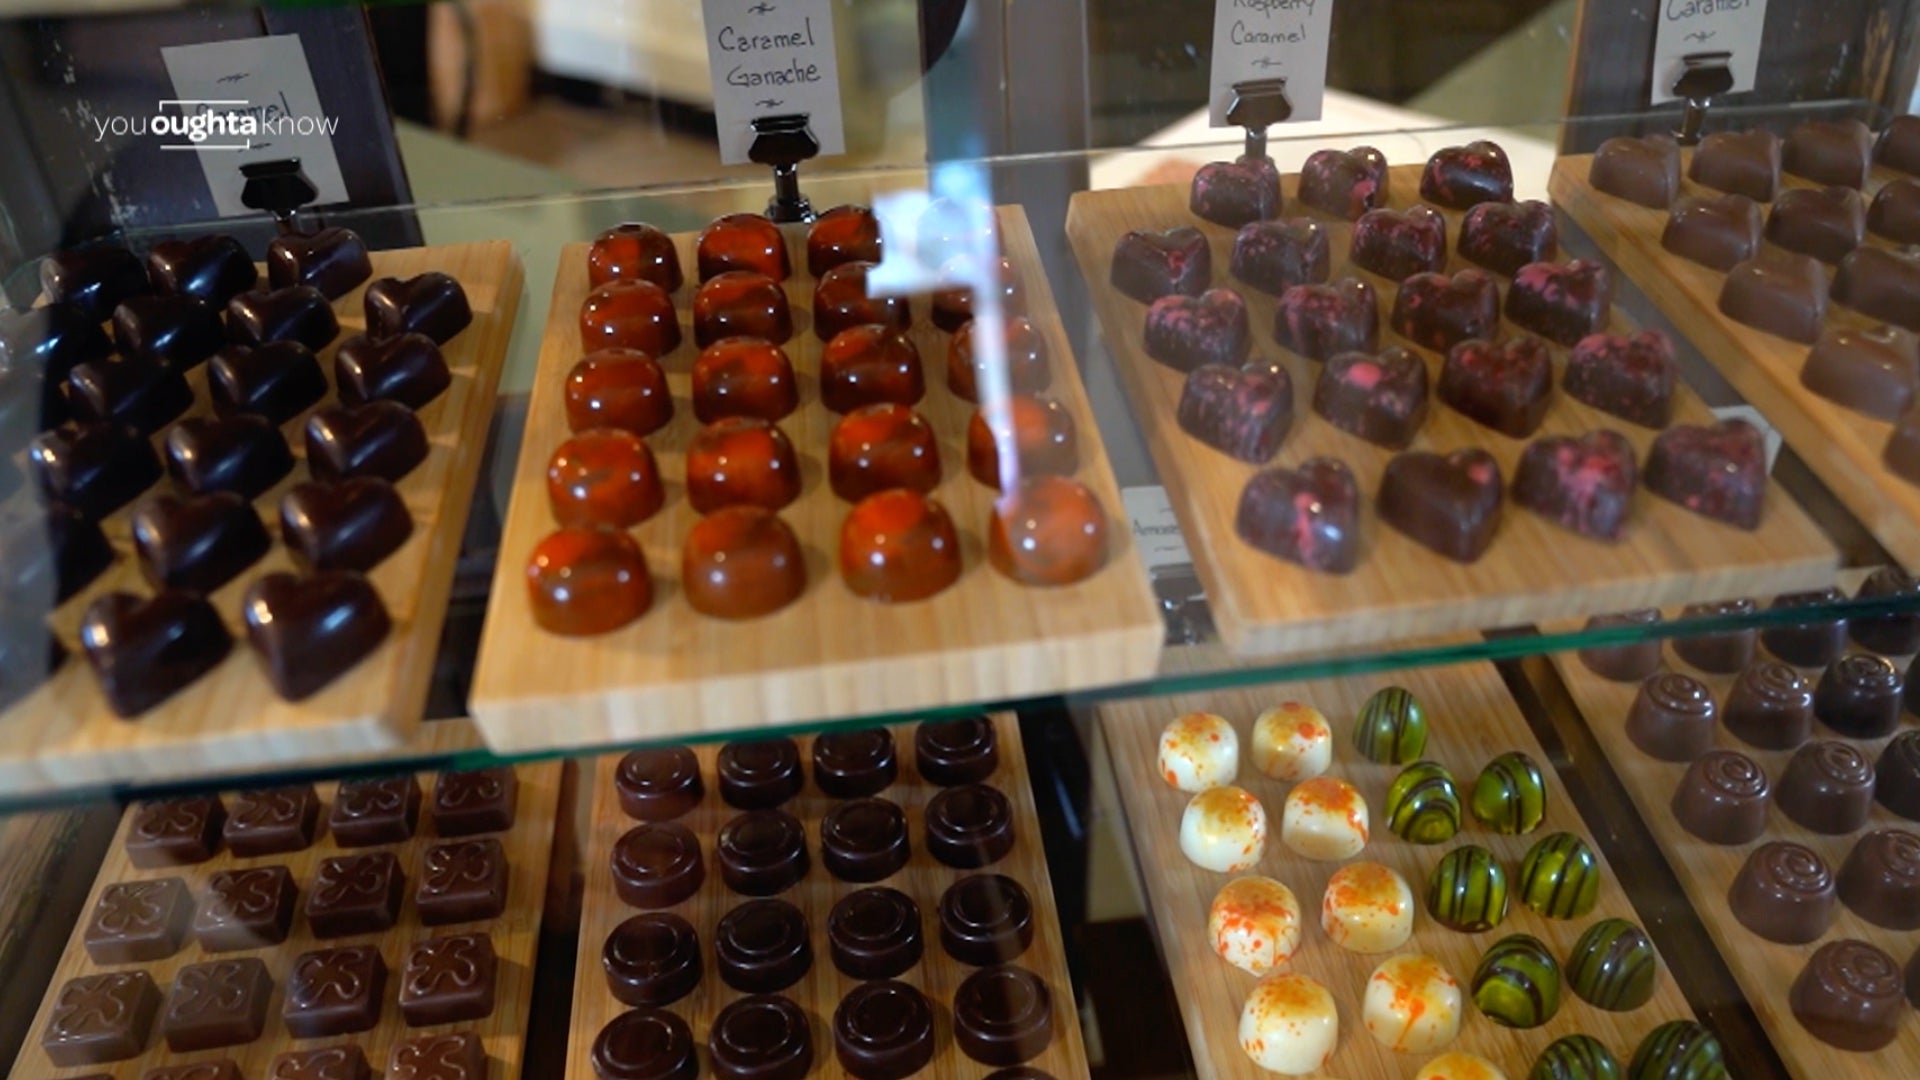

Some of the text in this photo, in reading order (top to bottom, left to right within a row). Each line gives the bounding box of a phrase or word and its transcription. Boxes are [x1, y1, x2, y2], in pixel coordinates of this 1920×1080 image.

[718, 16, 815, 51] Caramel
[1231, 20, 1306, 45] Caramel
[727, 57, 821, 87] Ganache
